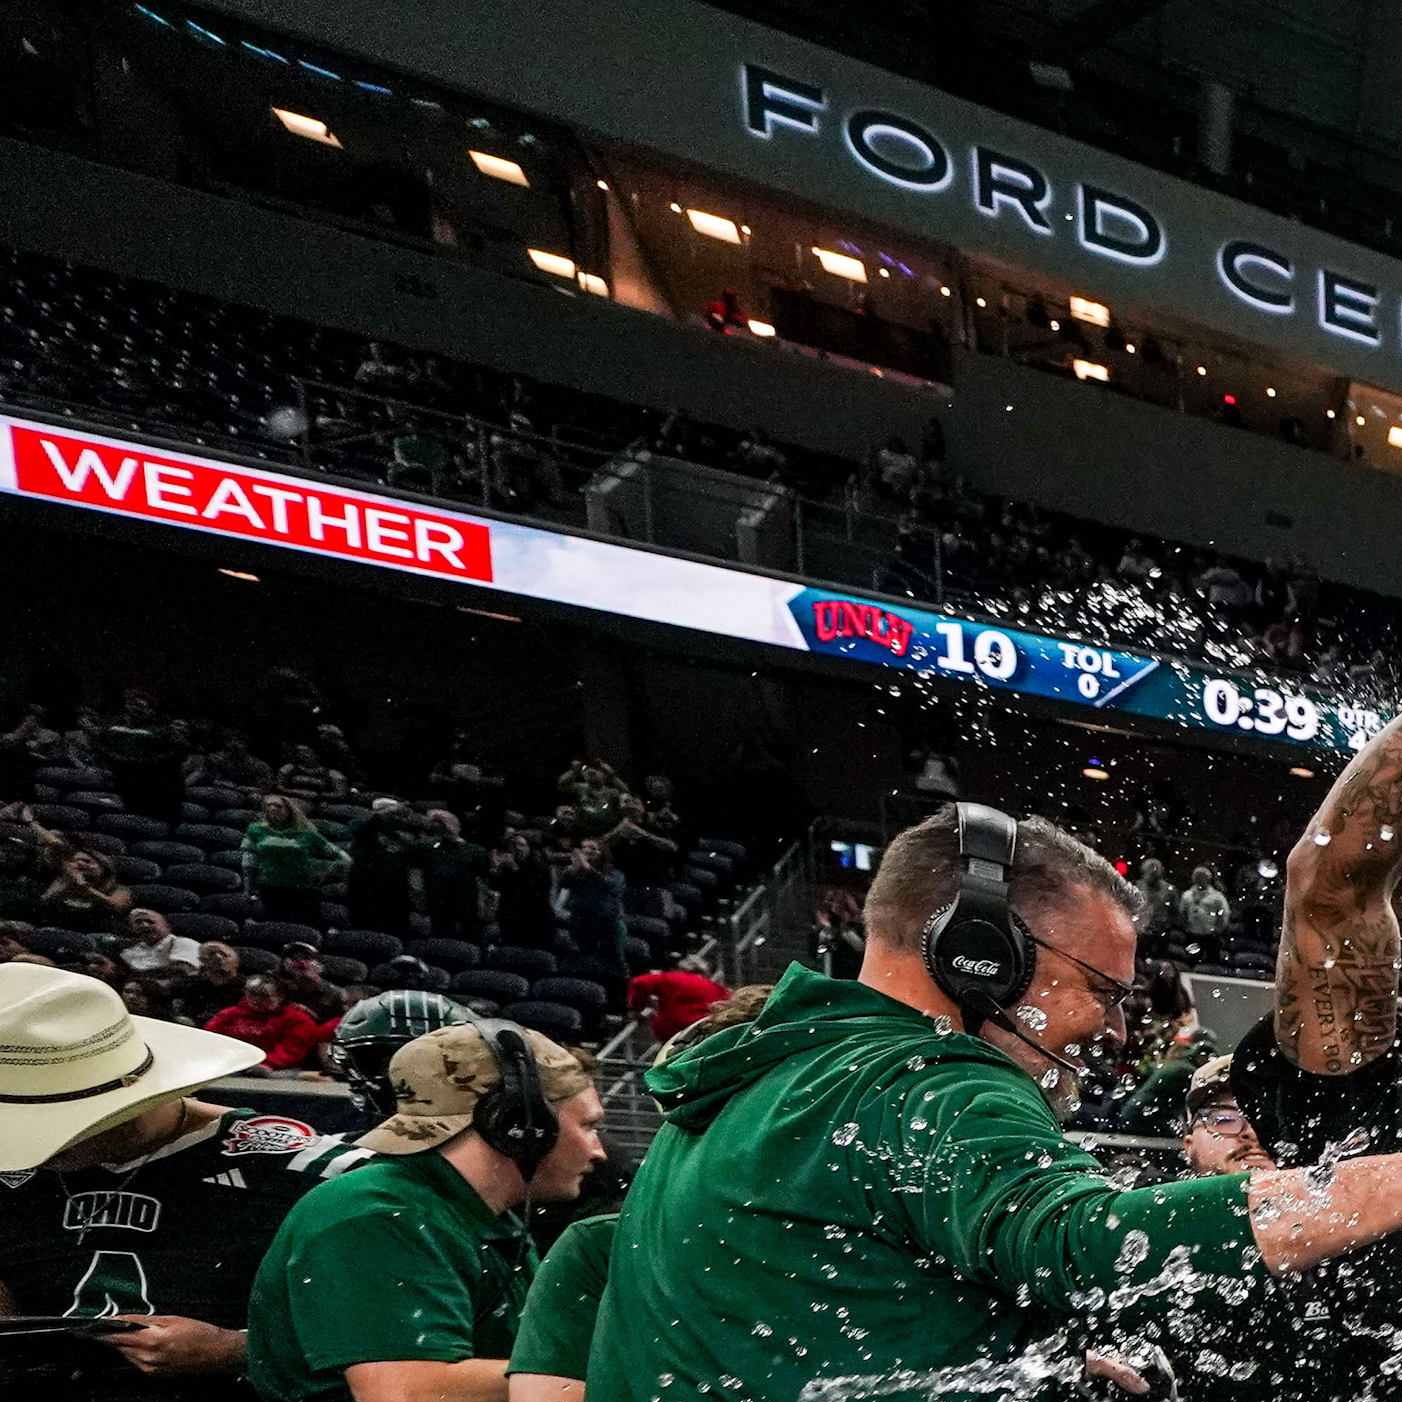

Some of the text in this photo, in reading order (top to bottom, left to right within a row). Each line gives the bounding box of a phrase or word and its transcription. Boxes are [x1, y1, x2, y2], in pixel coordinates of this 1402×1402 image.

[741, 62, 1167, 267] FORD
[38, 439, 467, 570] WEATHER
[813, 600, 1017, 680] UNLV 10
[1057, 642, 1121, 678] TOL
[1077, 673, 1100, 699] 0
[1203, 679, 1320, 741] 0:39
[62, 1190, 162, 1233] OHIO
